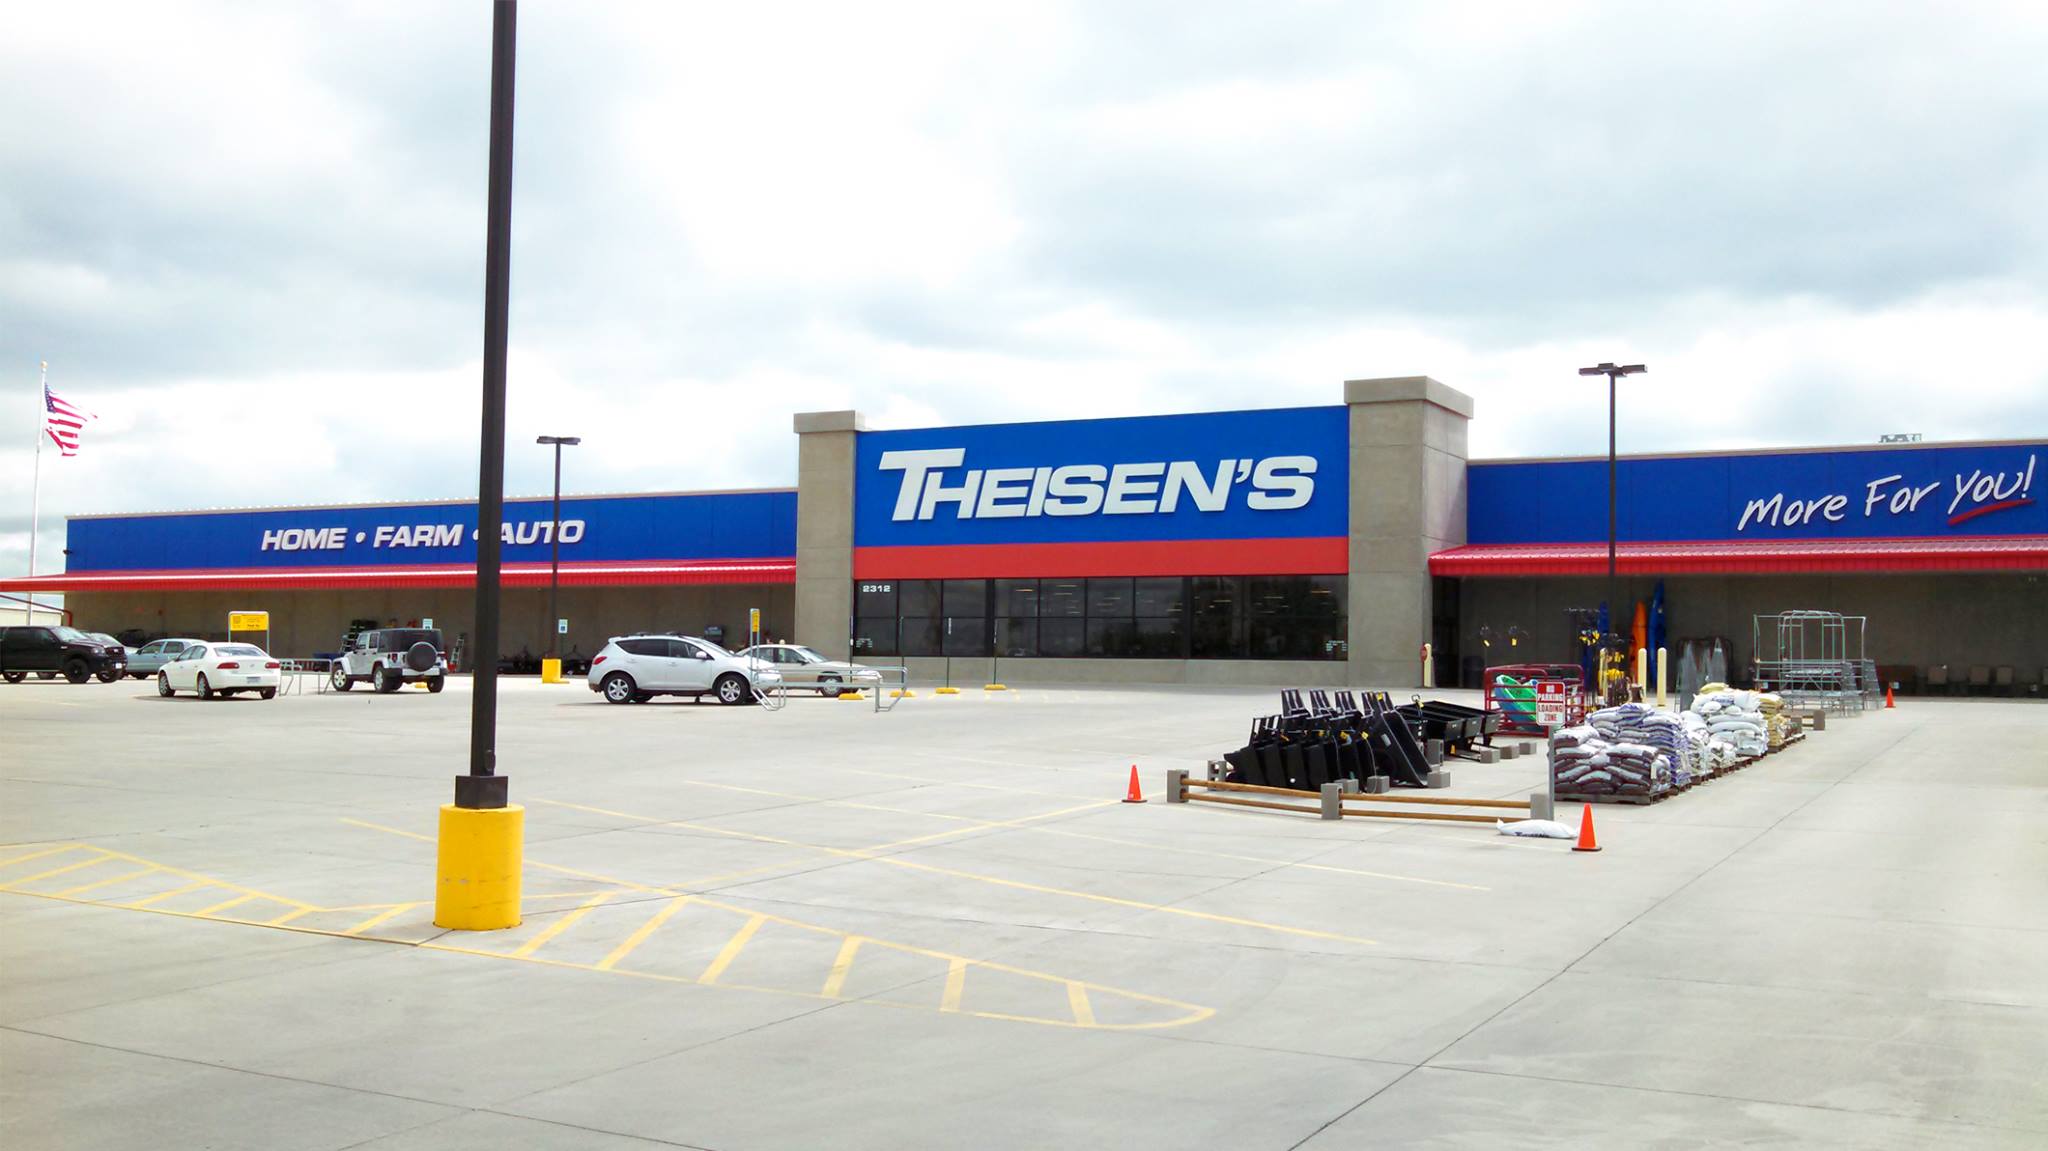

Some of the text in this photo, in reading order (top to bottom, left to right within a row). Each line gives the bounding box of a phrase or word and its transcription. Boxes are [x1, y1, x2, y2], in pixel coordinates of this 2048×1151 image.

[878, 447, 1318, 521] THEISEN'S
[1737, 454, 2035, 531] More For You!
[261, 519, 585, 551] HOME FARM AUTO
[862, 584, 891, 593] 2312
[1537, 693, 1563, 701] PARKING
[1537, 704, 1563, 712] LOADING
[1544, 713, 1557, 721] ZONE
